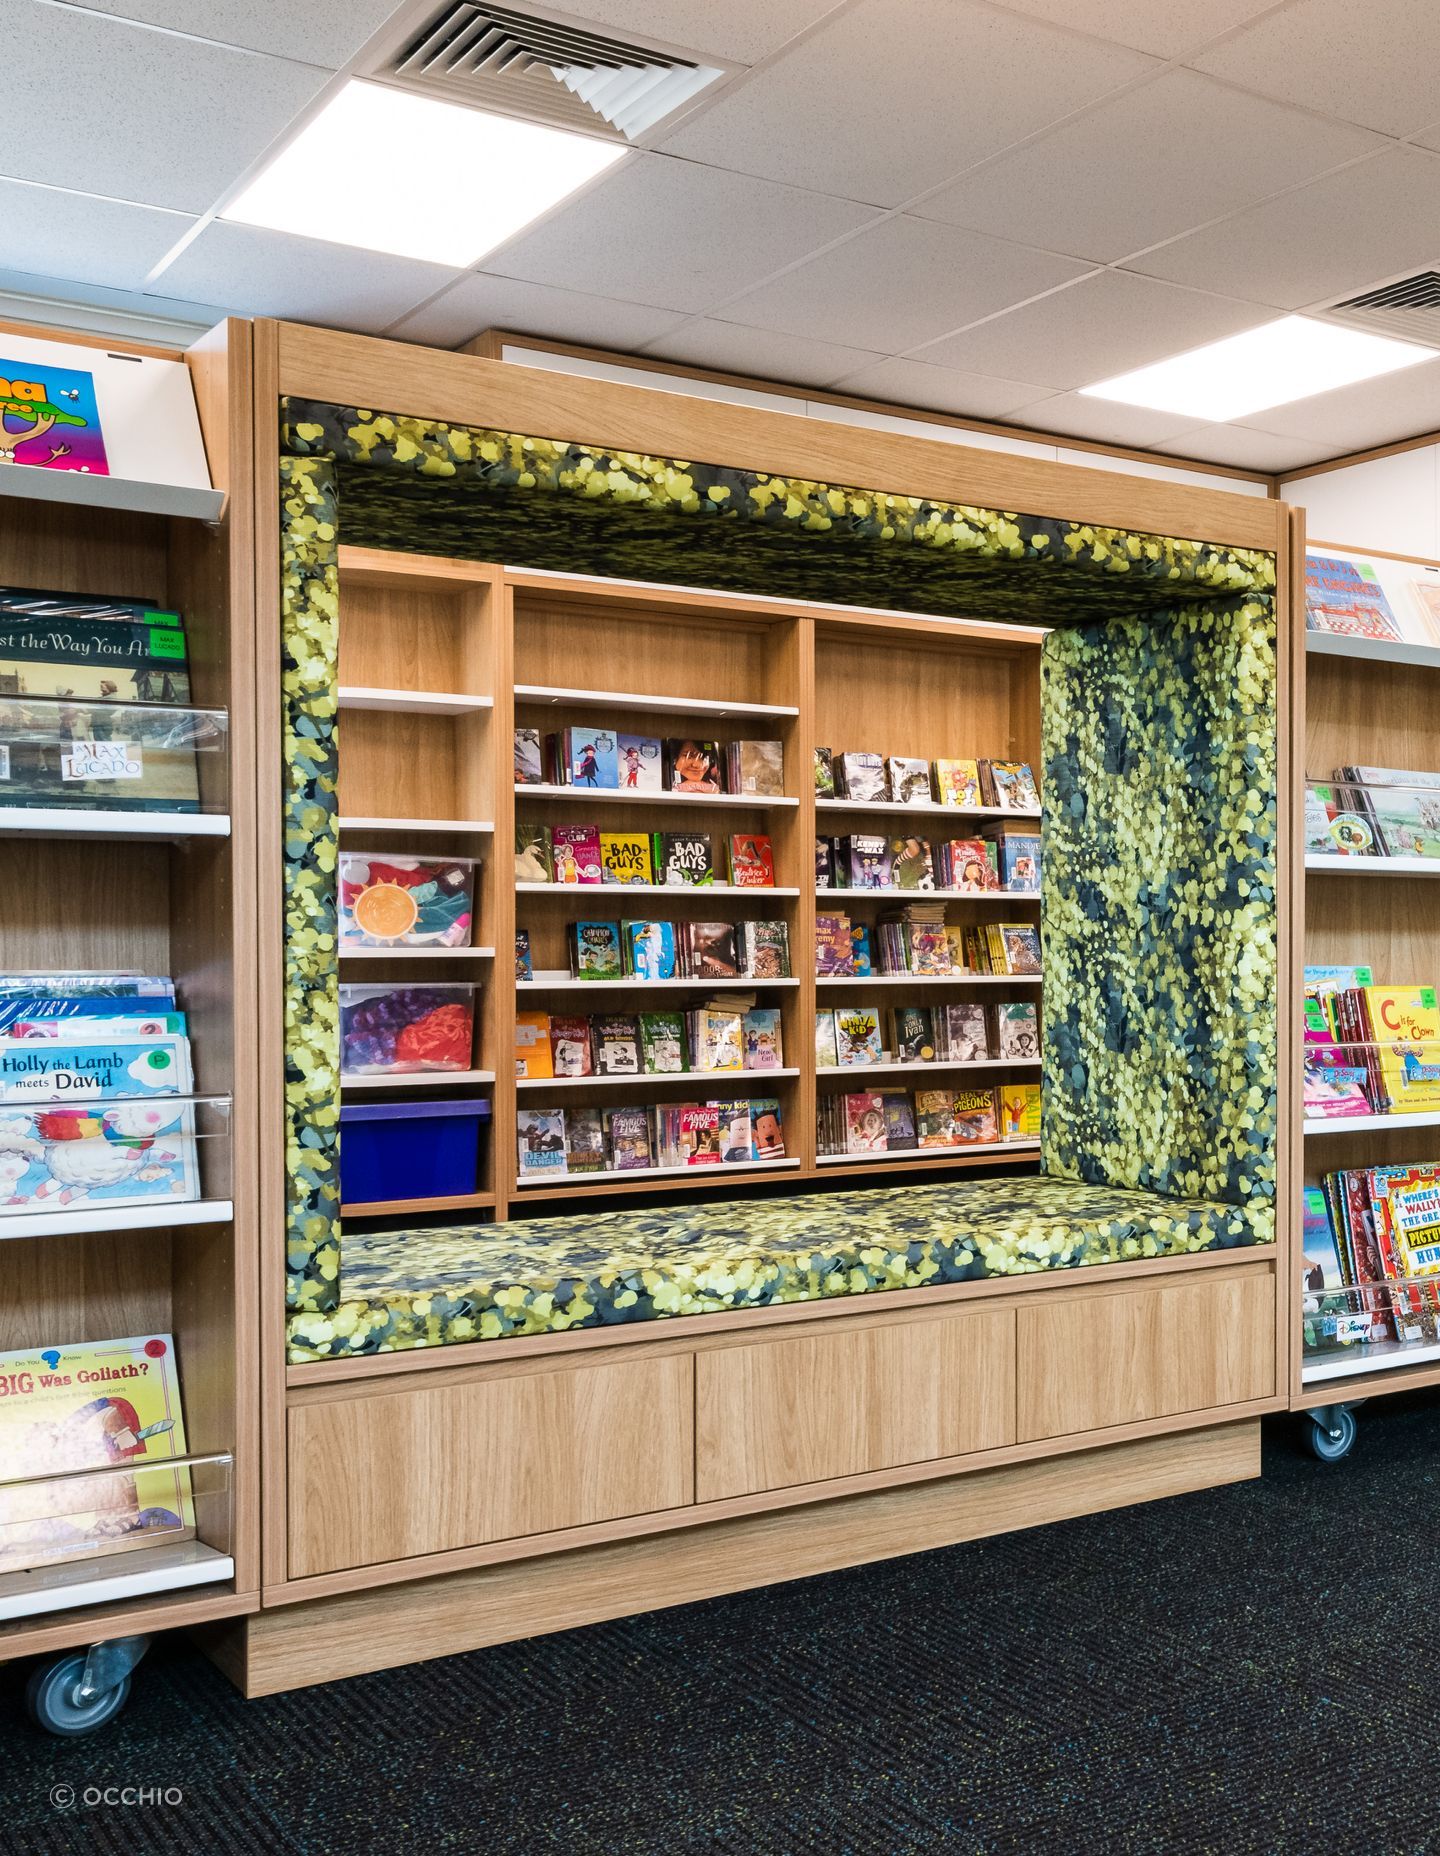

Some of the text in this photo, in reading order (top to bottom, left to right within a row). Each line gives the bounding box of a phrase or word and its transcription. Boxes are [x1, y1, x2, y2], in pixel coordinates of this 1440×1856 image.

[20, 633, 47, 649] the
[48, 632, 90, 656] Way
[91, 636, 122, 655] You
[126, 639, 151, 657] Ar
[154, 642, 181, 651] LUCADO
[66, 759, 140, 778] LUCADO
[610, 843, 642, 856] BAD
[675, 842, 705, 857] BAD
[605, 856, 644, 870] GUYS
[669, 855, 707, 870] GUYS
[1380, 999, 1401, 1030] C
[905, 1025, 924, 1038] Ivan
[1411, 1026, 1435, 1040] Clown
[2, 1052, 123, 1075] Holly the Lamb
[15, 1072, 113, 1090] meets David
[960, 1091, 977, 1101] REAL
[613, 1117, 647, 1127] FAMOUS
[683, 1112, 719, 1123] FAMOUS
[620, 1124, 641, 1133] FIVE
[689, 1121, 711, 1130] FIVE
[1402, 1189, 1439, 1204] WHERE'S
[1405, 1198, 1440, 1215] WALLY?
[1401, 1215, 1420, 1227] THE
[0, 1362, 149, 1397] BIG Was Goliath?
[92, 1386, 127, 1396] questions
